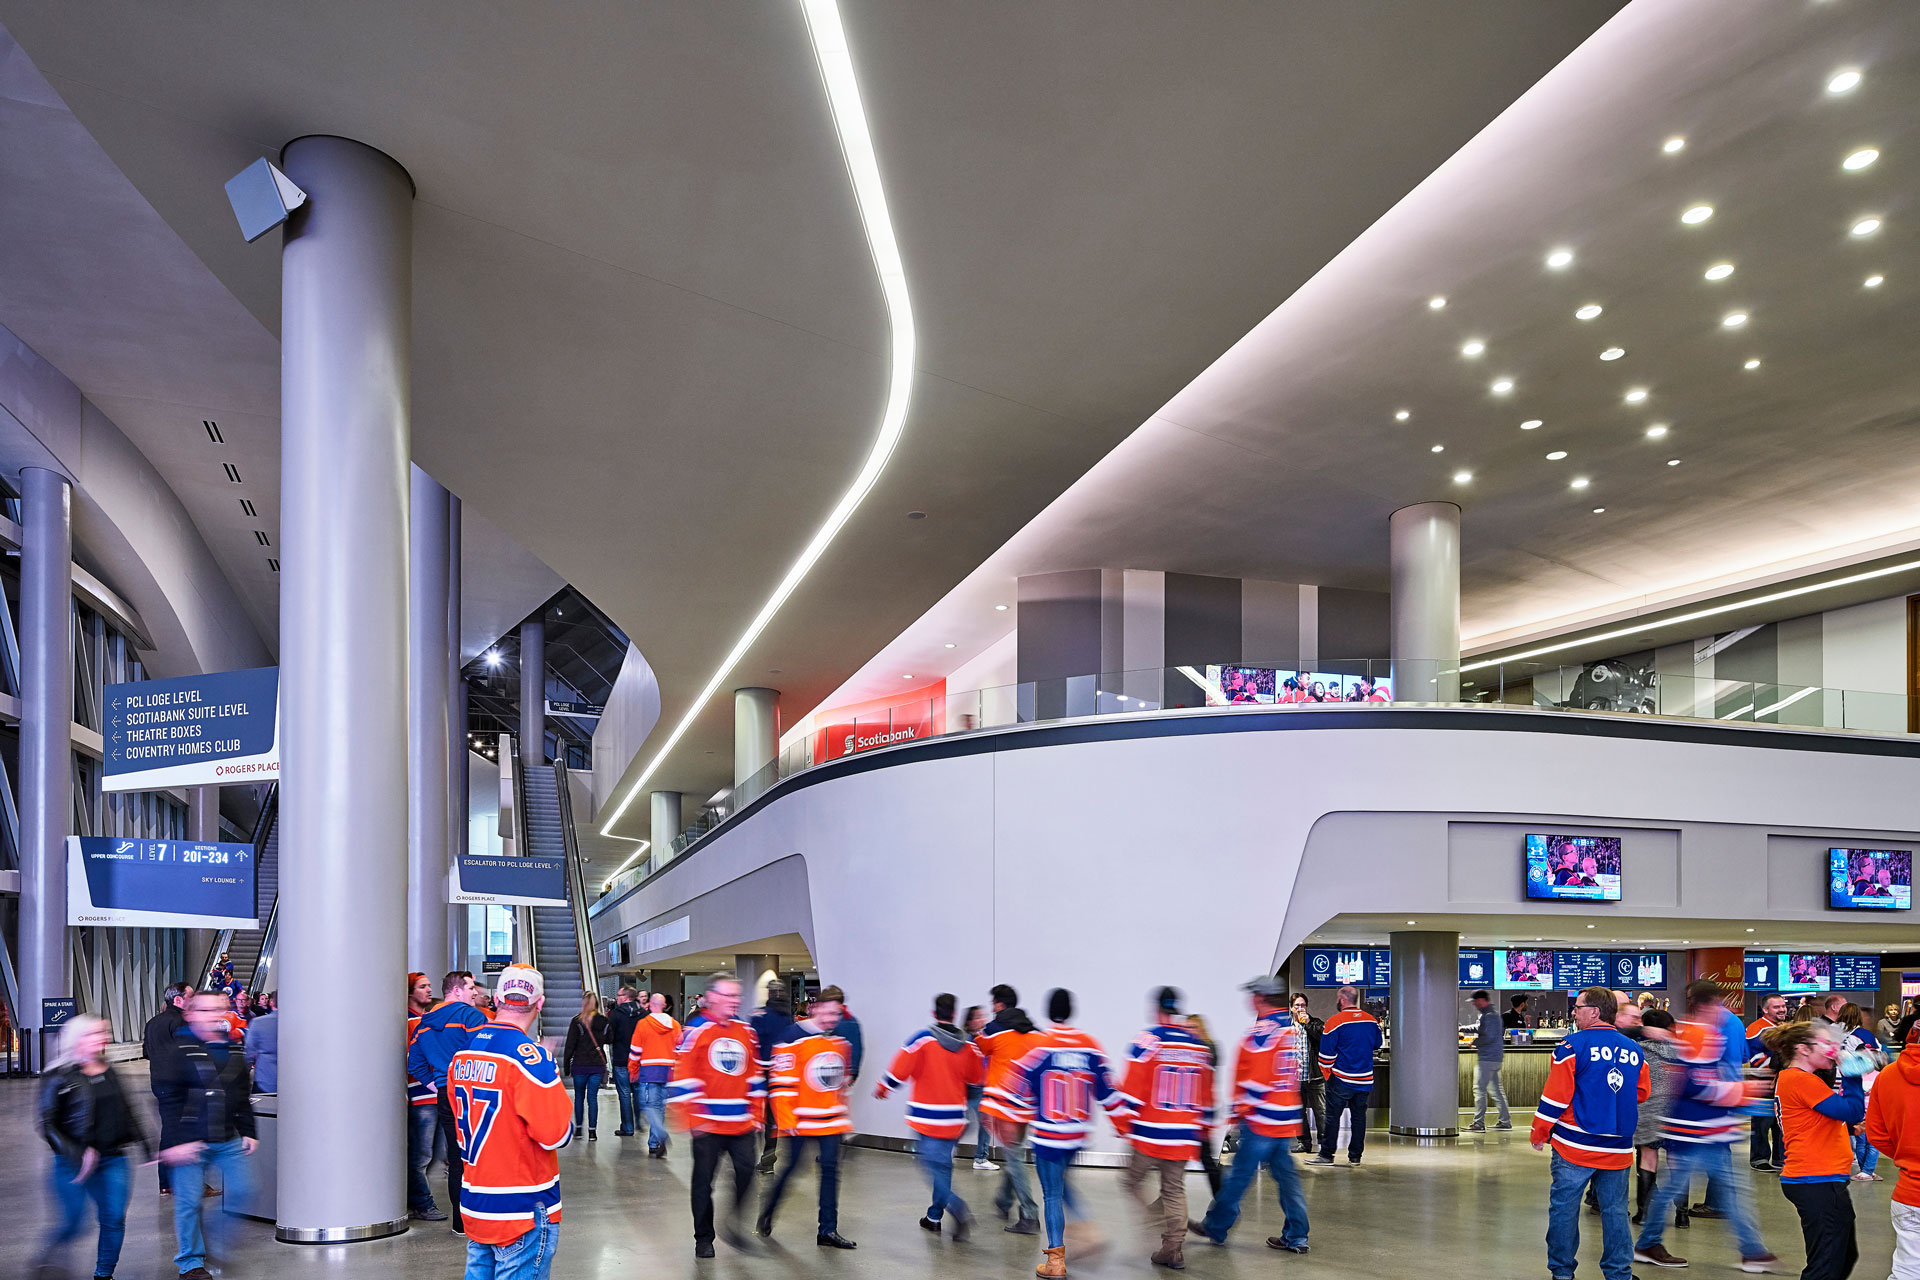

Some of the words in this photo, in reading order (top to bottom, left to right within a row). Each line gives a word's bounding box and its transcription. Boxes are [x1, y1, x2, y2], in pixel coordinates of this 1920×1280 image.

[126, 696, 144, 709] PCL
[146, 693, 171, 707] LOGE
[173, 690, 202, 704] LEVEL
[126, 709, 185, 726] SCOTIABANK
[188, 705, 216, 720] SUITE
[218, 703, 249, 717] LEVEL
[126, 727, 168, 742] THEATRE
[170, 725, 202, 739] BOXES
[858, 726, 915, 748] Scotiabank
[126, 744, 175, 760] COVENTRY
[178, 741, 211, 755] HOMES
[214, 739, 241, 752] CLUB
[225, 764, 256, 775] ROGERS
[257, 762, 280, 772] PLACE
[157, 843, 167, 861] 7
[183, 850, 228, 864] 201-234
[463, 859, 497, 867] ESCALATOR
[503, 978, 535, 995] OILERS
[1590, 1046, 1640, 1066] 50/50
[453, 1058, 498, 1084] McDAVID
[454, 1084, 502, 1166] 97
